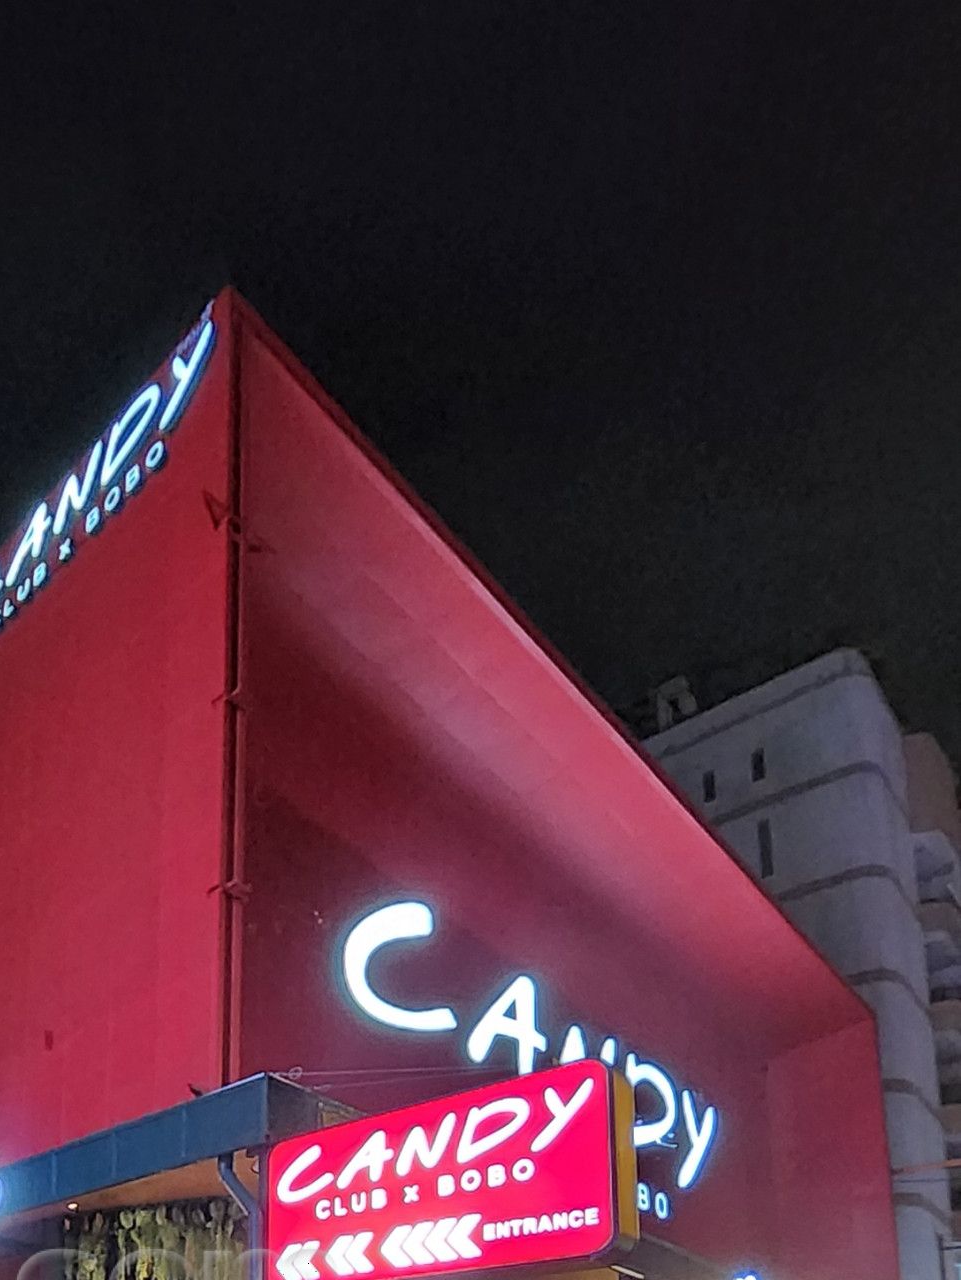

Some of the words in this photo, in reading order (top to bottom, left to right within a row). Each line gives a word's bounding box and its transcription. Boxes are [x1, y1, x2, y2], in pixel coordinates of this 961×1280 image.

[86, 440, 163, 534] BOBO
[276, 1078, 595, 1203] CANDY
[315, 1188, 388, 1220] CLUB
[436, 1158, 536, 1197] BOBO
[482, 1206, 600, 1242] ENTRANCE
